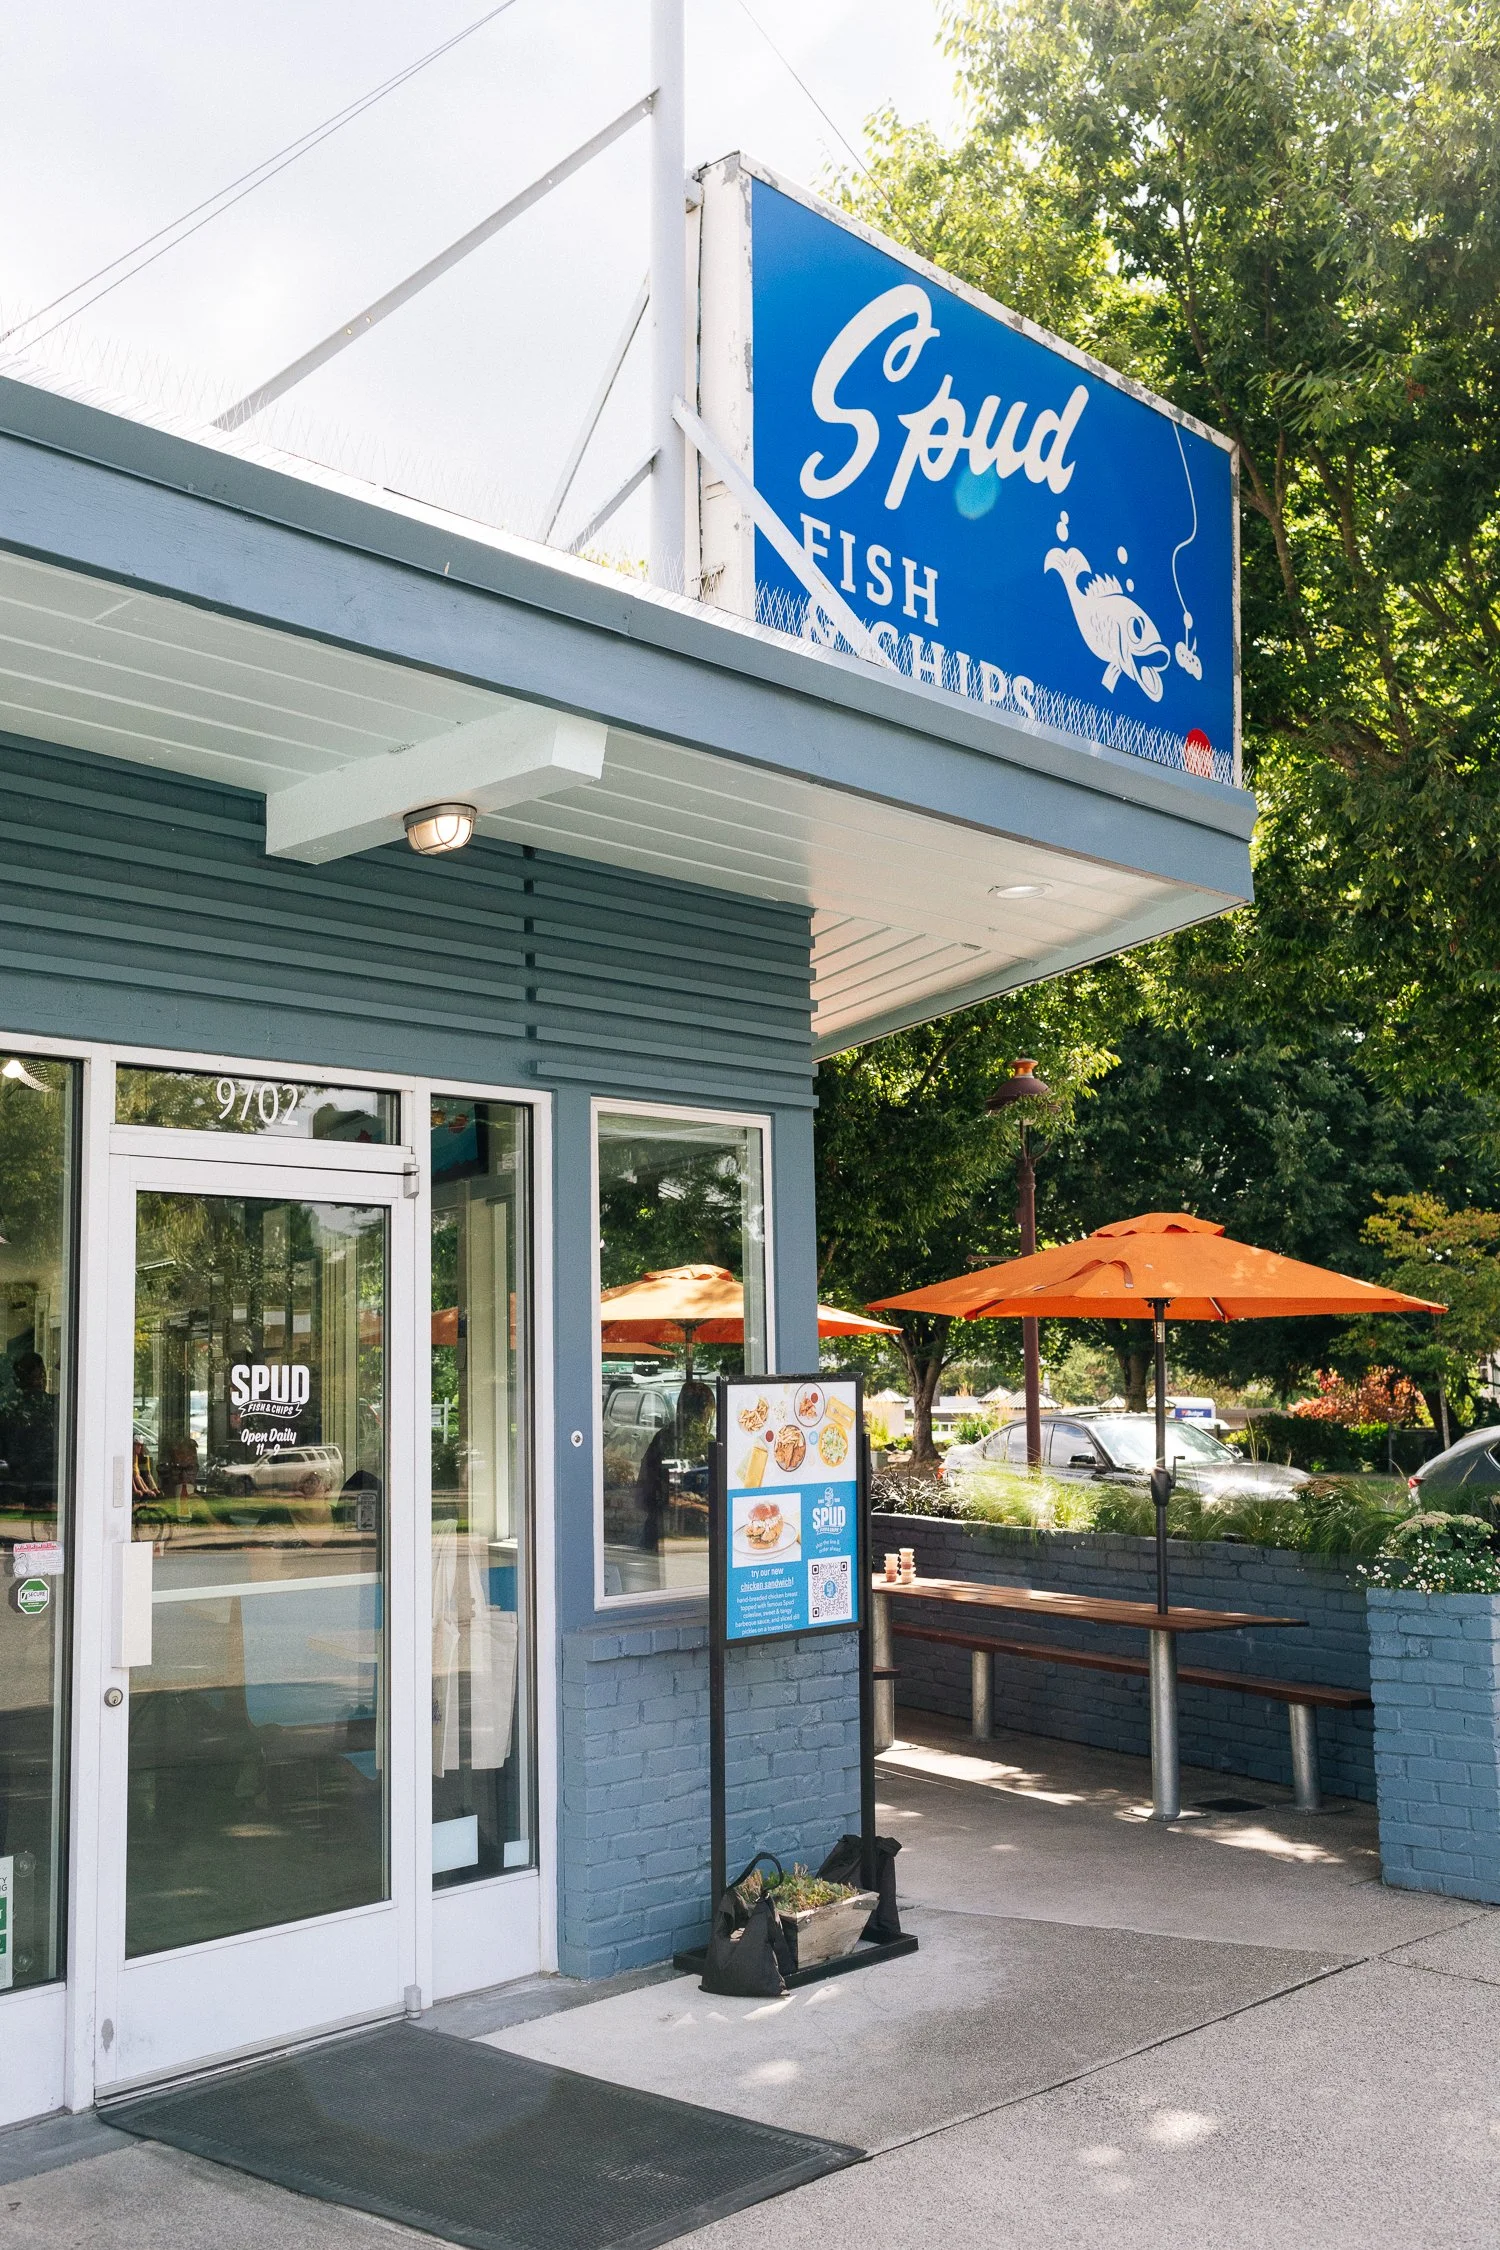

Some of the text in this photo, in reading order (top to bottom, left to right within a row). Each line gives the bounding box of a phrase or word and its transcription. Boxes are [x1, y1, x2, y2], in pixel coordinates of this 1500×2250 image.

[800, 284, 1090, 510] Spud
[800, 512, 939, 627] FISH
[216, 1077, 298, 1126] 9702
[231, 1364, 309, 1406] SPUD
[247, 1403, 266, 1413] FISH
[271, 1405, 294, 1415] CHIPS
[241, 1428, 296, 1445] Open Daily
[812, 1505, 846, 1530] SPUD
[740, 1577, 794, 1591] chicken sandwich!
[751, 1570, 759, 1578] try
